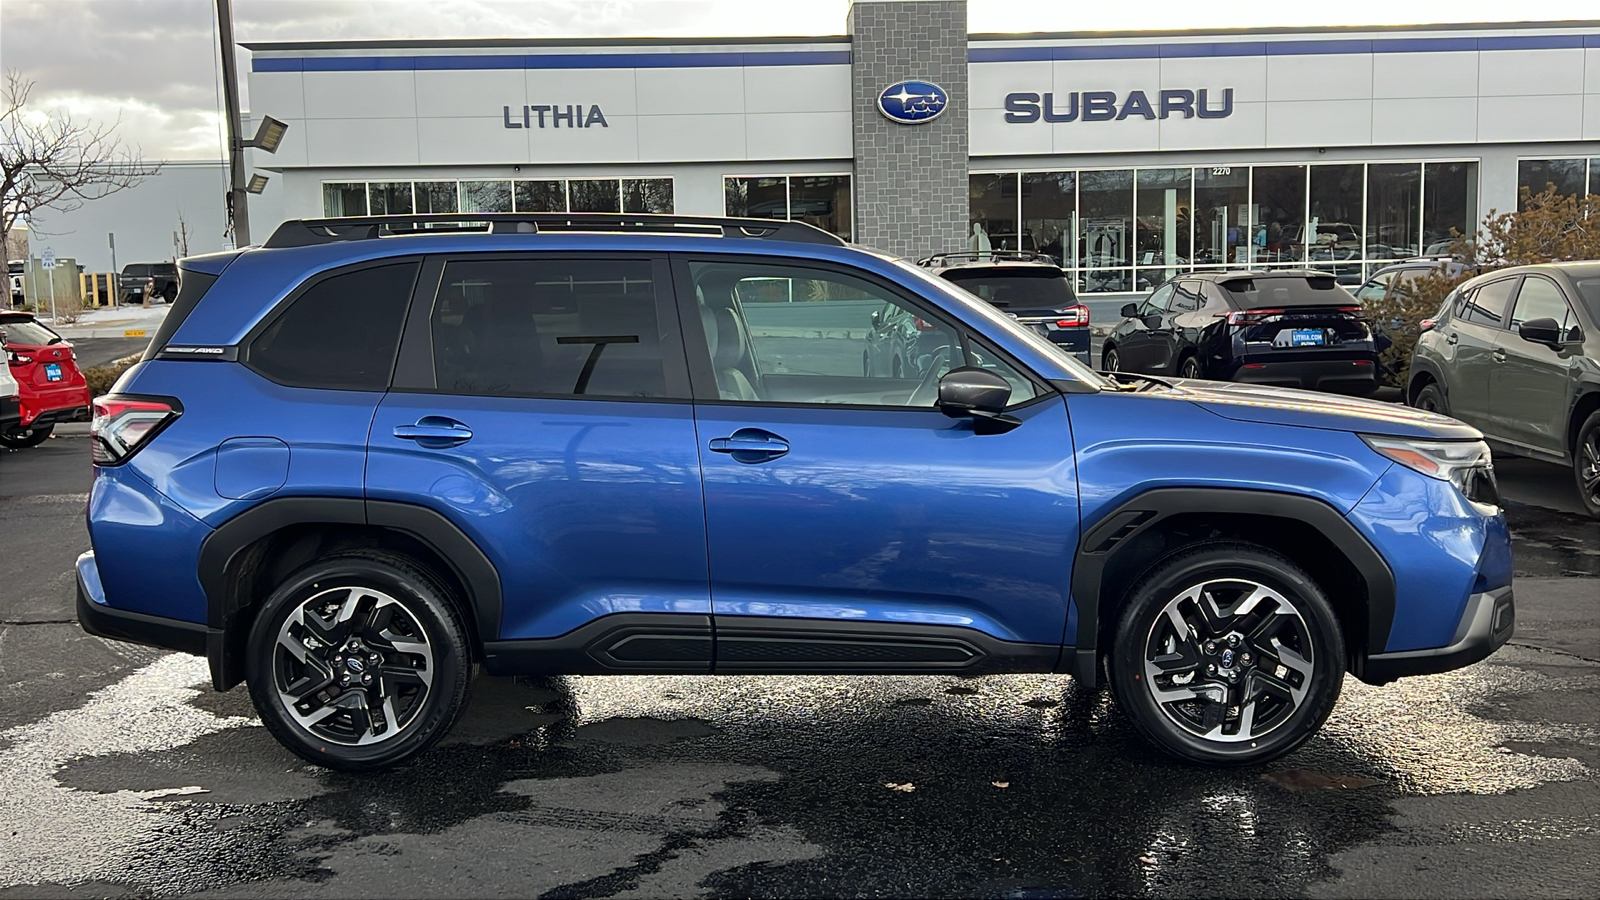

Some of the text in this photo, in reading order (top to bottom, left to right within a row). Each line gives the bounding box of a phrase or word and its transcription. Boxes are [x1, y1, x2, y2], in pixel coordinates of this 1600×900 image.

[503, 105, 608, 128] LITHIA
[1004, 88, 1234, 123] SUBARU
[1212, 167, 1231, 176] 2270
